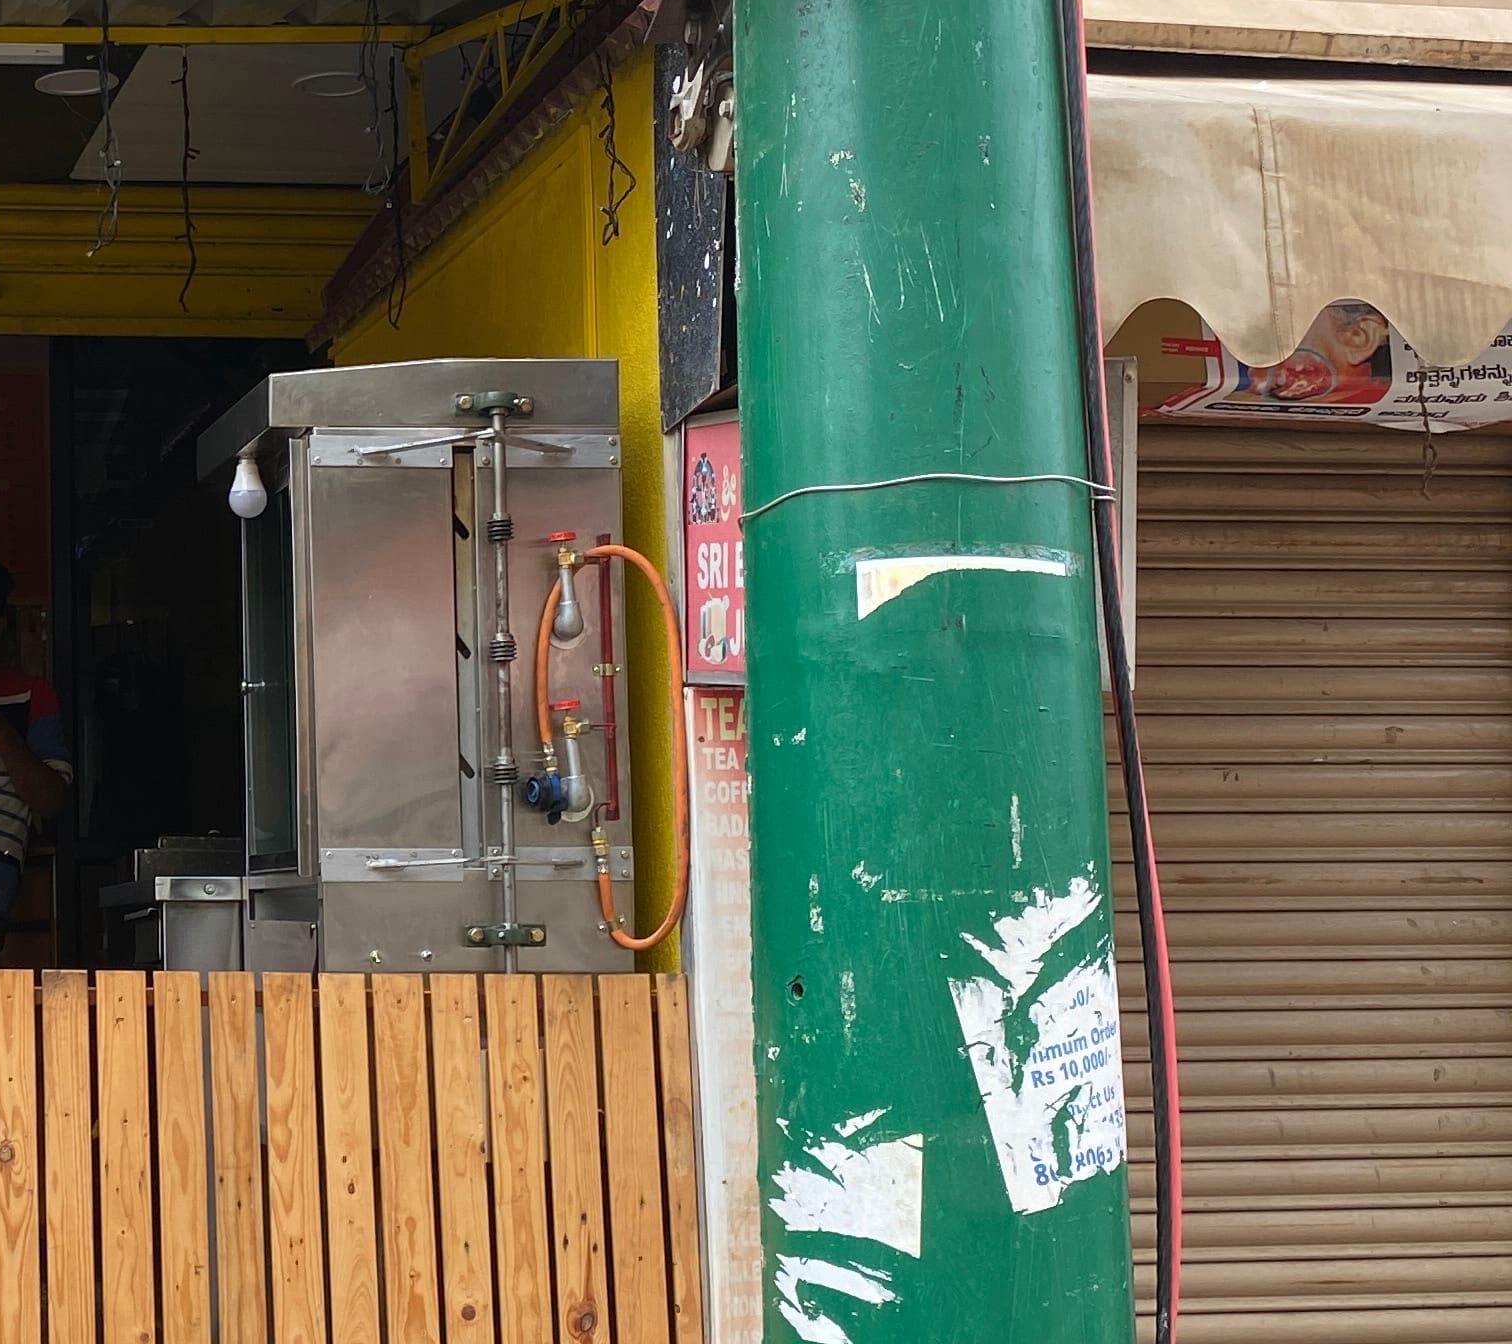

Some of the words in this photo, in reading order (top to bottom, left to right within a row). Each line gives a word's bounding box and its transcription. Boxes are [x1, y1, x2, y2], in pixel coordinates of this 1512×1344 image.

[697, 542, 728, 589] SRI
[702, 747, 740, 770] TEA
[1031, 1070, 1055, 1088] Rs
